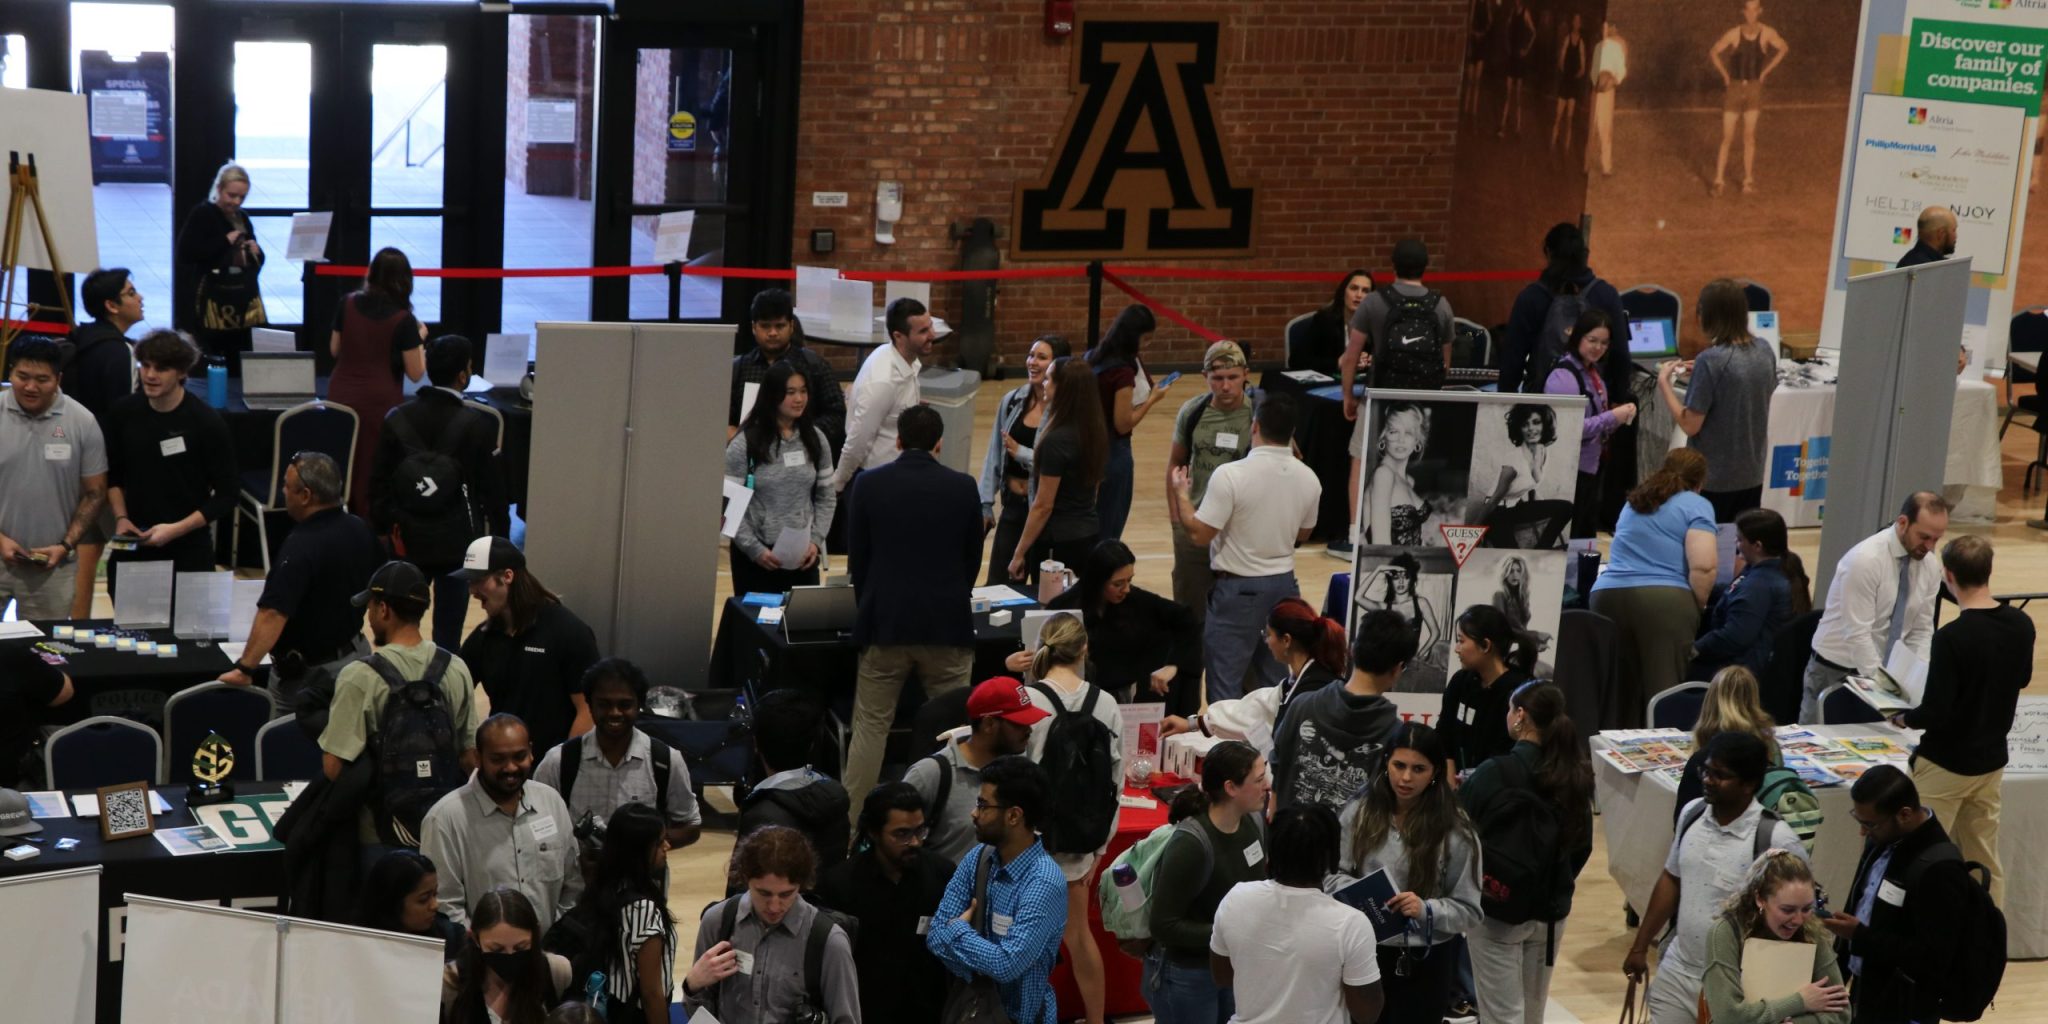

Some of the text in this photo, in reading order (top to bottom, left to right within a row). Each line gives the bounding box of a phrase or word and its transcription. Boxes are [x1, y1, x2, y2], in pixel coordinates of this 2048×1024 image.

[1920, 31, 2044, 57] Discover our
[1954, 54, 2042, 76] family of
[105, 80, 148, 89] SPECIAL
[1927, 73, 2038, 95] companies.
[1950, 203, 1996, 220] NJOY
[1793, 456, 1829, 469] Togeth
[1784, 469, 1828, 482] Togethe
[1446, 527, 1480, 539] GUESS
[97, 691, 161, 706] POLICE
